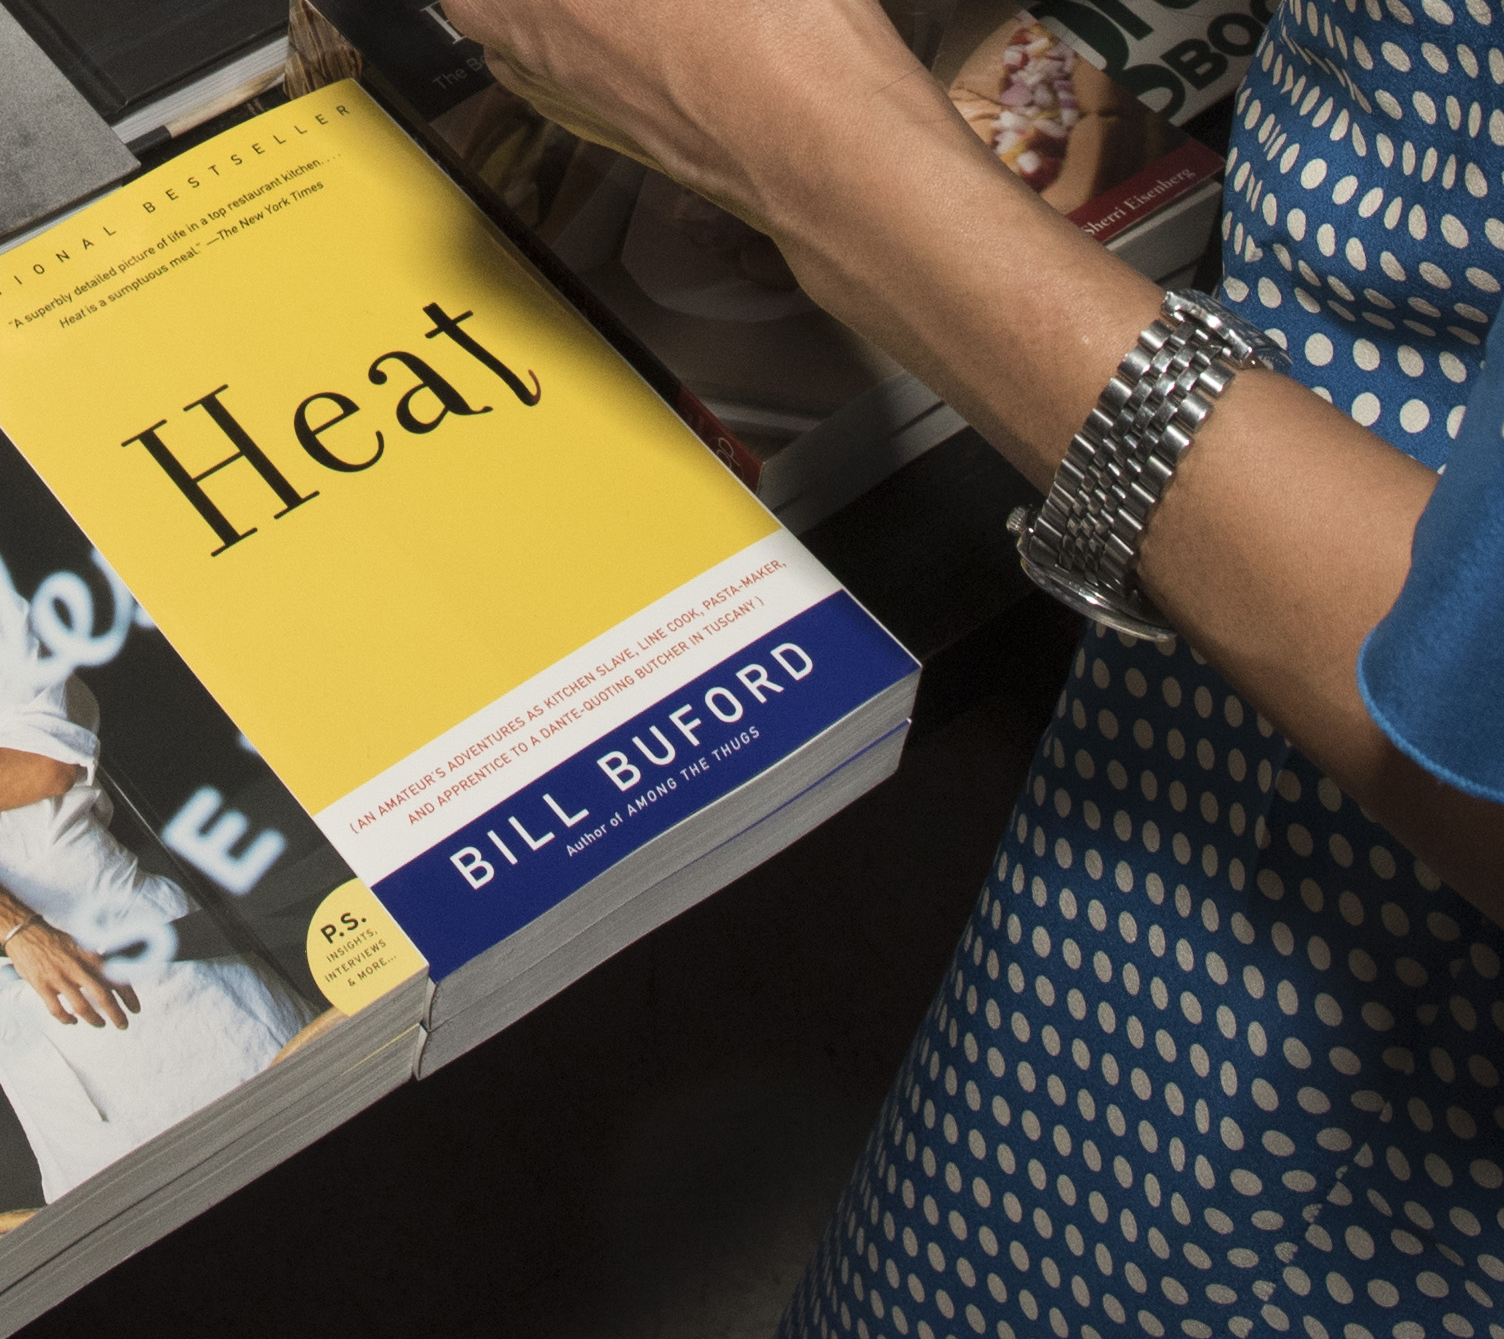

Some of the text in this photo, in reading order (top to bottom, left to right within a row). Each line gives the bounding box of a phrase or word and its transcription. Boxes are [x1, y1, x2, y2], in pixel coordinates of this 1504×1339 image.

[143, 103, 353, 215] BESTSELLER
[1124, 168, 1195, 210] Eisenberg
[121, 301, 543, 559] Heat
[407, 802, 435, 825] AND
[437, 758, 510, 807] APPRENTICE
[510, 744, 529, 758] TO
[530, 735, 540, 746] A
[540, 677, 635, 740] DANTE-QUOTING
[634, 642, 690, 681] BUTCHER
[689, 631, 704, 646] IN
[449, 638, 816, 889] BILL BUFORD
[564, 724, 762, 857] Author of AMONG THE THUGS
[321, 912, 366, 943] P.S.
[325, 939, 386, 983] INTERVIEWS
[326, 928, 378, 962] INSIGHTS,
[348, 978, 355, 986] &
